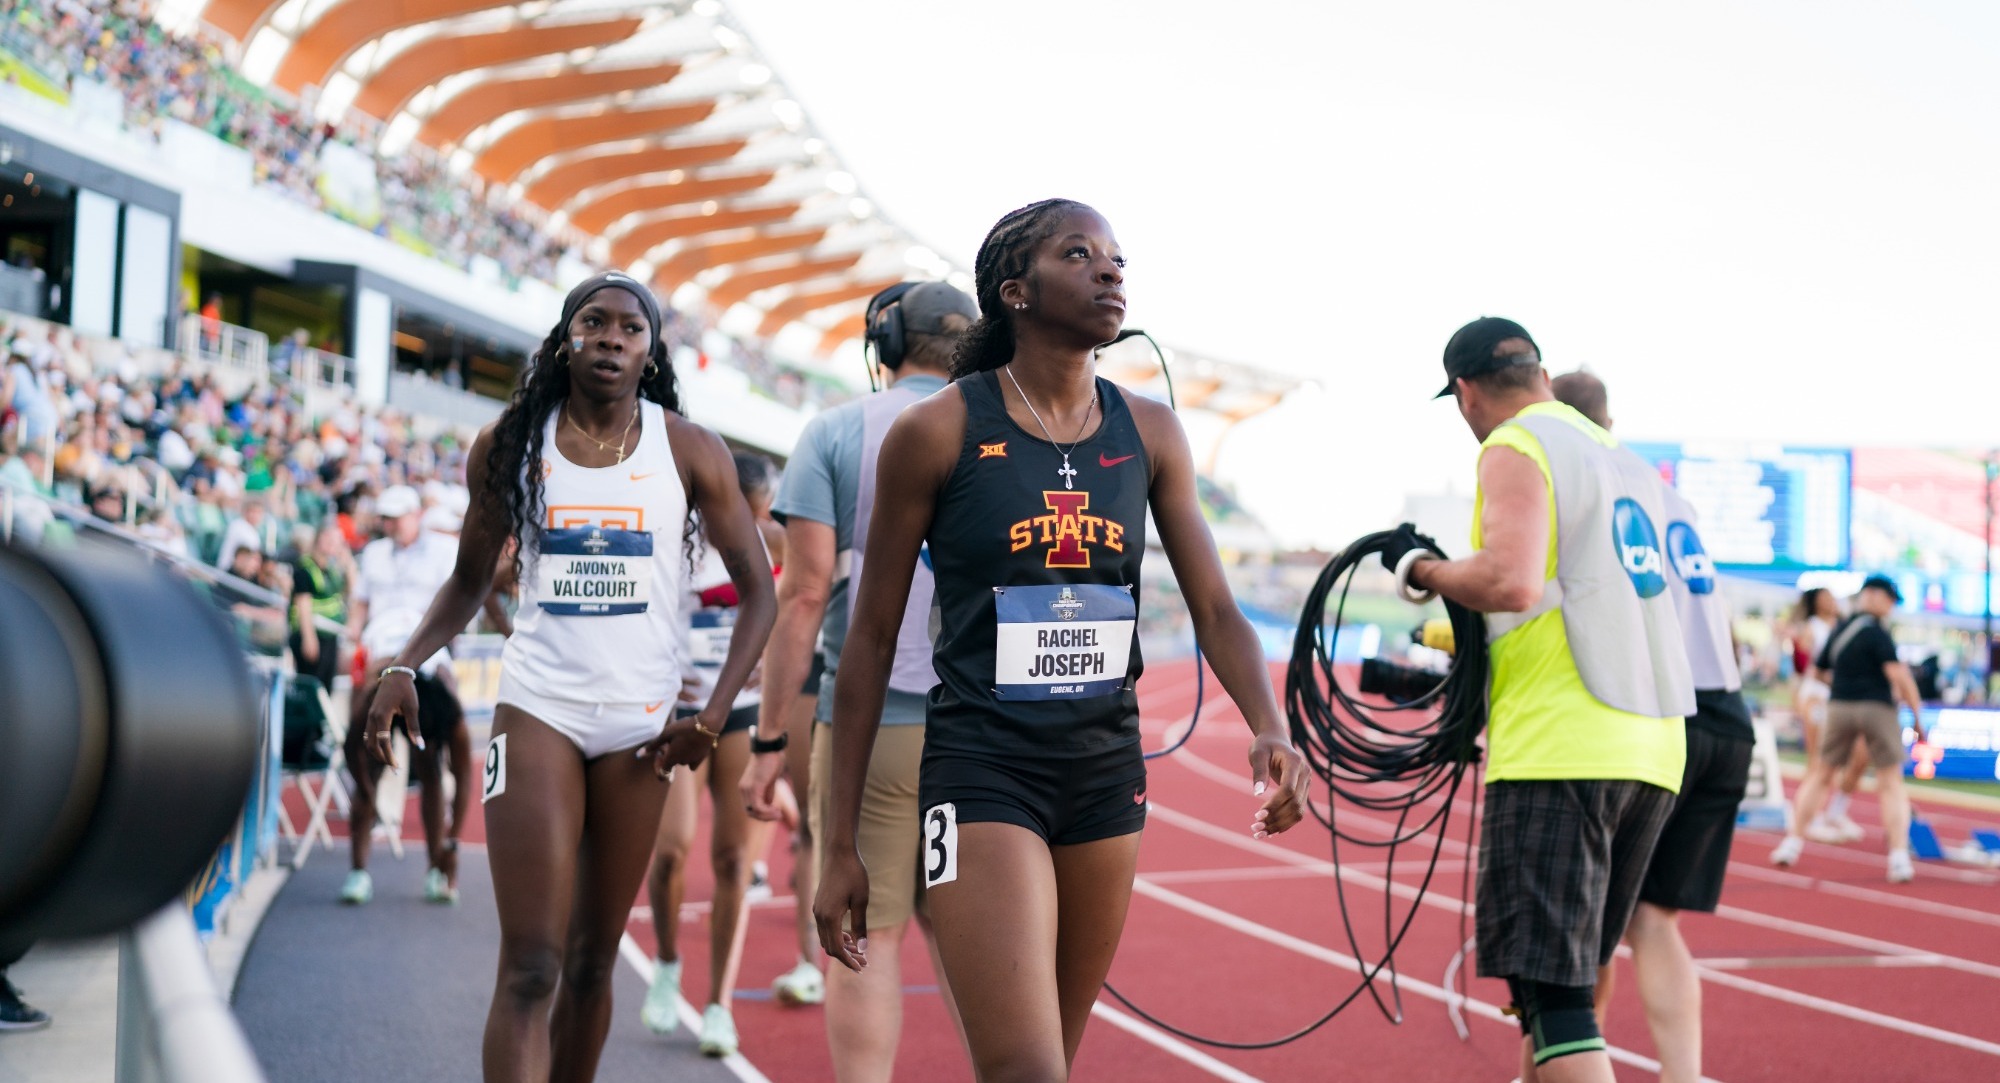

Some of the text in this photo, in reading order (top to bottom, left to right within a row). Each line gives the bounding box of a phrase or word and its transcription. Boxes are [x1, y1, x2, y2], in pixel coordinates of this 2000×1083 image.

[1009, 514, 1125, 554] STATE
[566, 560, 626, 575] JAVONYA
[553, 579, 638, 597] VALCOURT
[1037, 628, 1099, 648] RACHEL
[1028, 651, 1105, 678] JOSEPH
[486, 742, 499, 795] 9
[928, 808, 947, 882] 3
